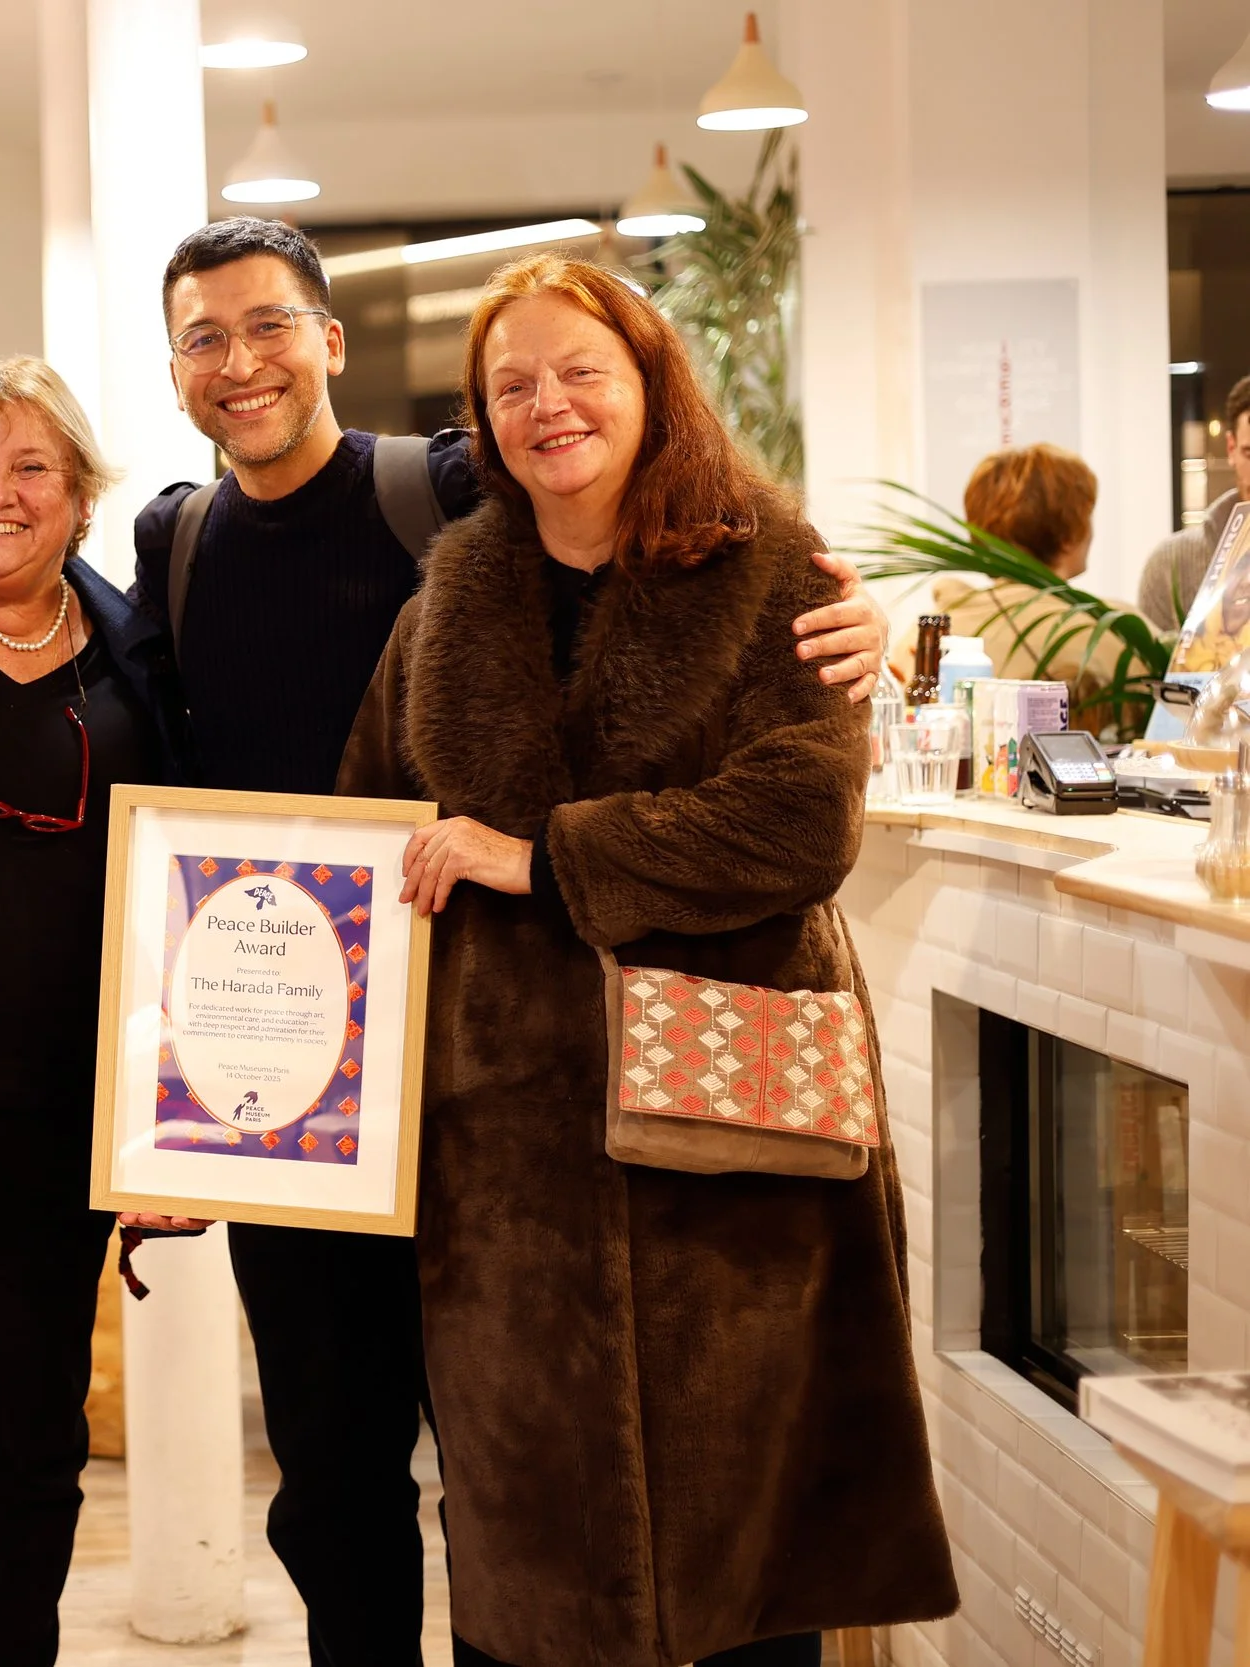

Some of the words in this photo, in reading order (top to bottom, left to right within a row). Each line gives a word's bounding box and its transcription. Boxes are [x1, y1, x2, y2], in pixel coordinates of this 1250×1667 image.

[1209, 512, 1244, 583] HERO
[254, 888, 273, 902] PEACE
[207, 915, 256, 932] Peace
[260, 919, 316, 936] Builder
[234, 940, 286, 956] Award
[236, 967, 271, 976] Presented
[190, 977, 219, 991] The
[222, 979, 273, 995] Harada
[277, 982, 324, 1000] Family
[201, 1004, 234, 1012] dedicated
[286, 1010, 312, 1020] through
[196, 1014, 244, 1022] environmental
[276, 1018, 309, 1026] education
[203, 1022, 220, 1030] deep
[220, 1024, 246, 1032] respect
[260, 1026, 298, 1034] admiration
[182, 1030, 226, 1038] commitment
[236, 1033, 264, 1042] creating
[265, 1034, 295, 1044] harmony
[218, 1062, 238, 1070] Peace
[240, 1064, 272, 1073] Museums
[234, 1072, 262, 1080] October
[264, 1074, 281, 1082] 2025
